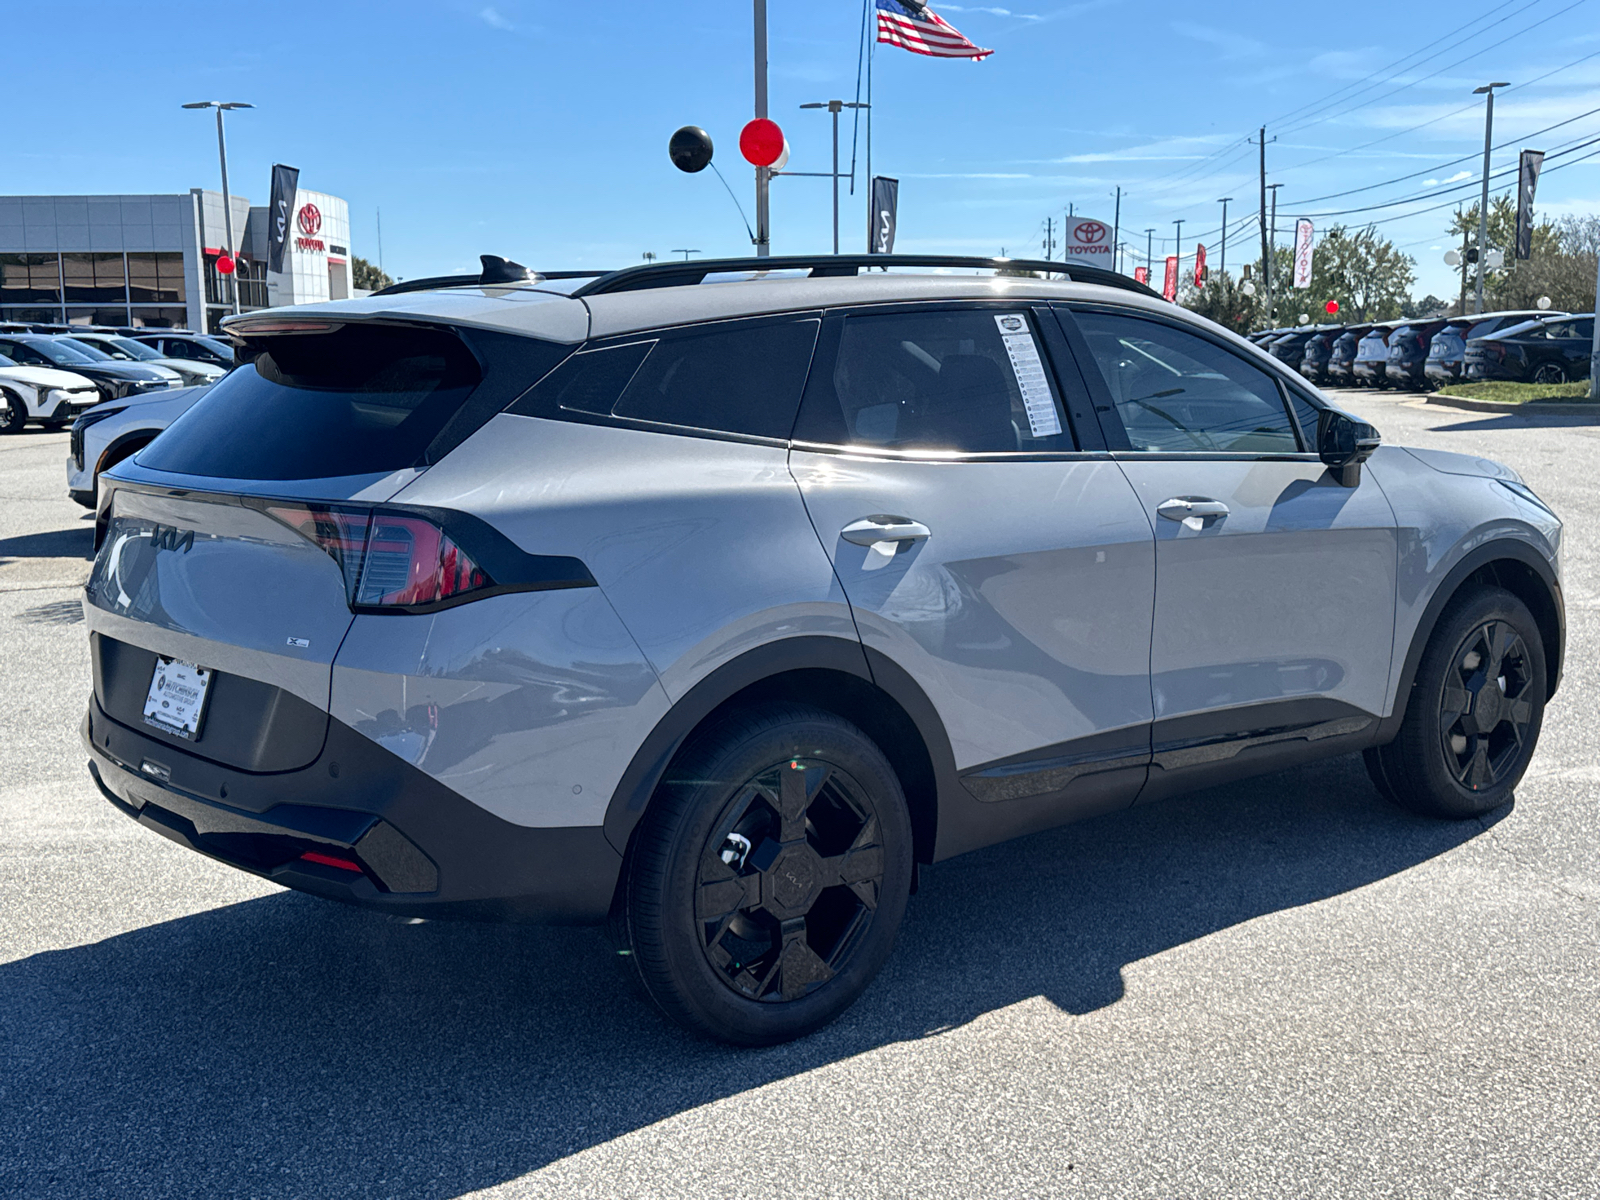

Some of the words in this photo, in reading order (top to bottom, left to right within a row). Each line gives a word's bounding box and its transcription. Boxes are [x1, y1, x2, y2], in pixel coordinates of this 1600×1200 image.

[297, 237, 325, 251] TOYOTA
[1068, 245, 1111, 255] TOYOTA
[1300, 234, 1308, 282] TOYOTA
[150, 523, 194, 554] KIA
